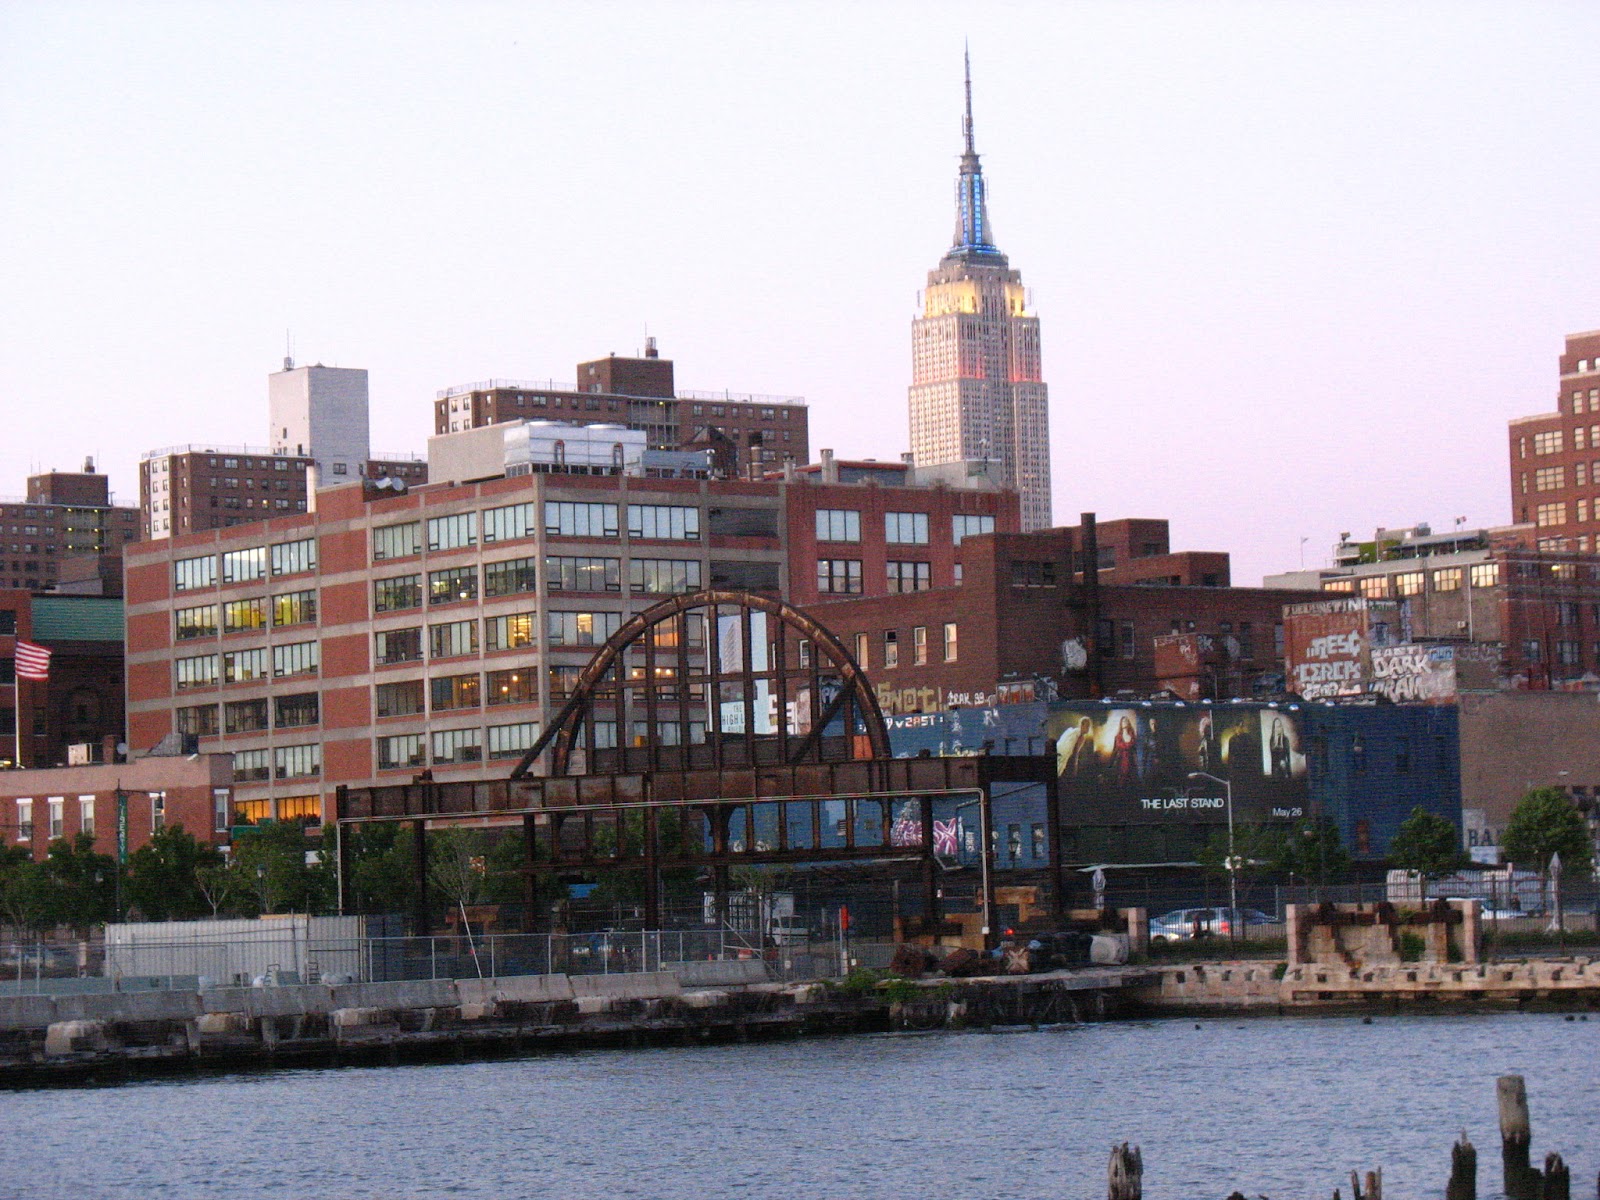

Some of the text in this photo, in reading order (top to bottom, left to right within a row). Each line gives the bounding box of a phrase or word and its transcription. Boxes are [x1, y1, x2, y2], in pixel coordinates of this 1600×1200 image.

[1373, 655, 1432, 678] DARK
[1141, 797, 1225, 809] THE LAST STAND
[1272, 807, 1303, 819] May 26
